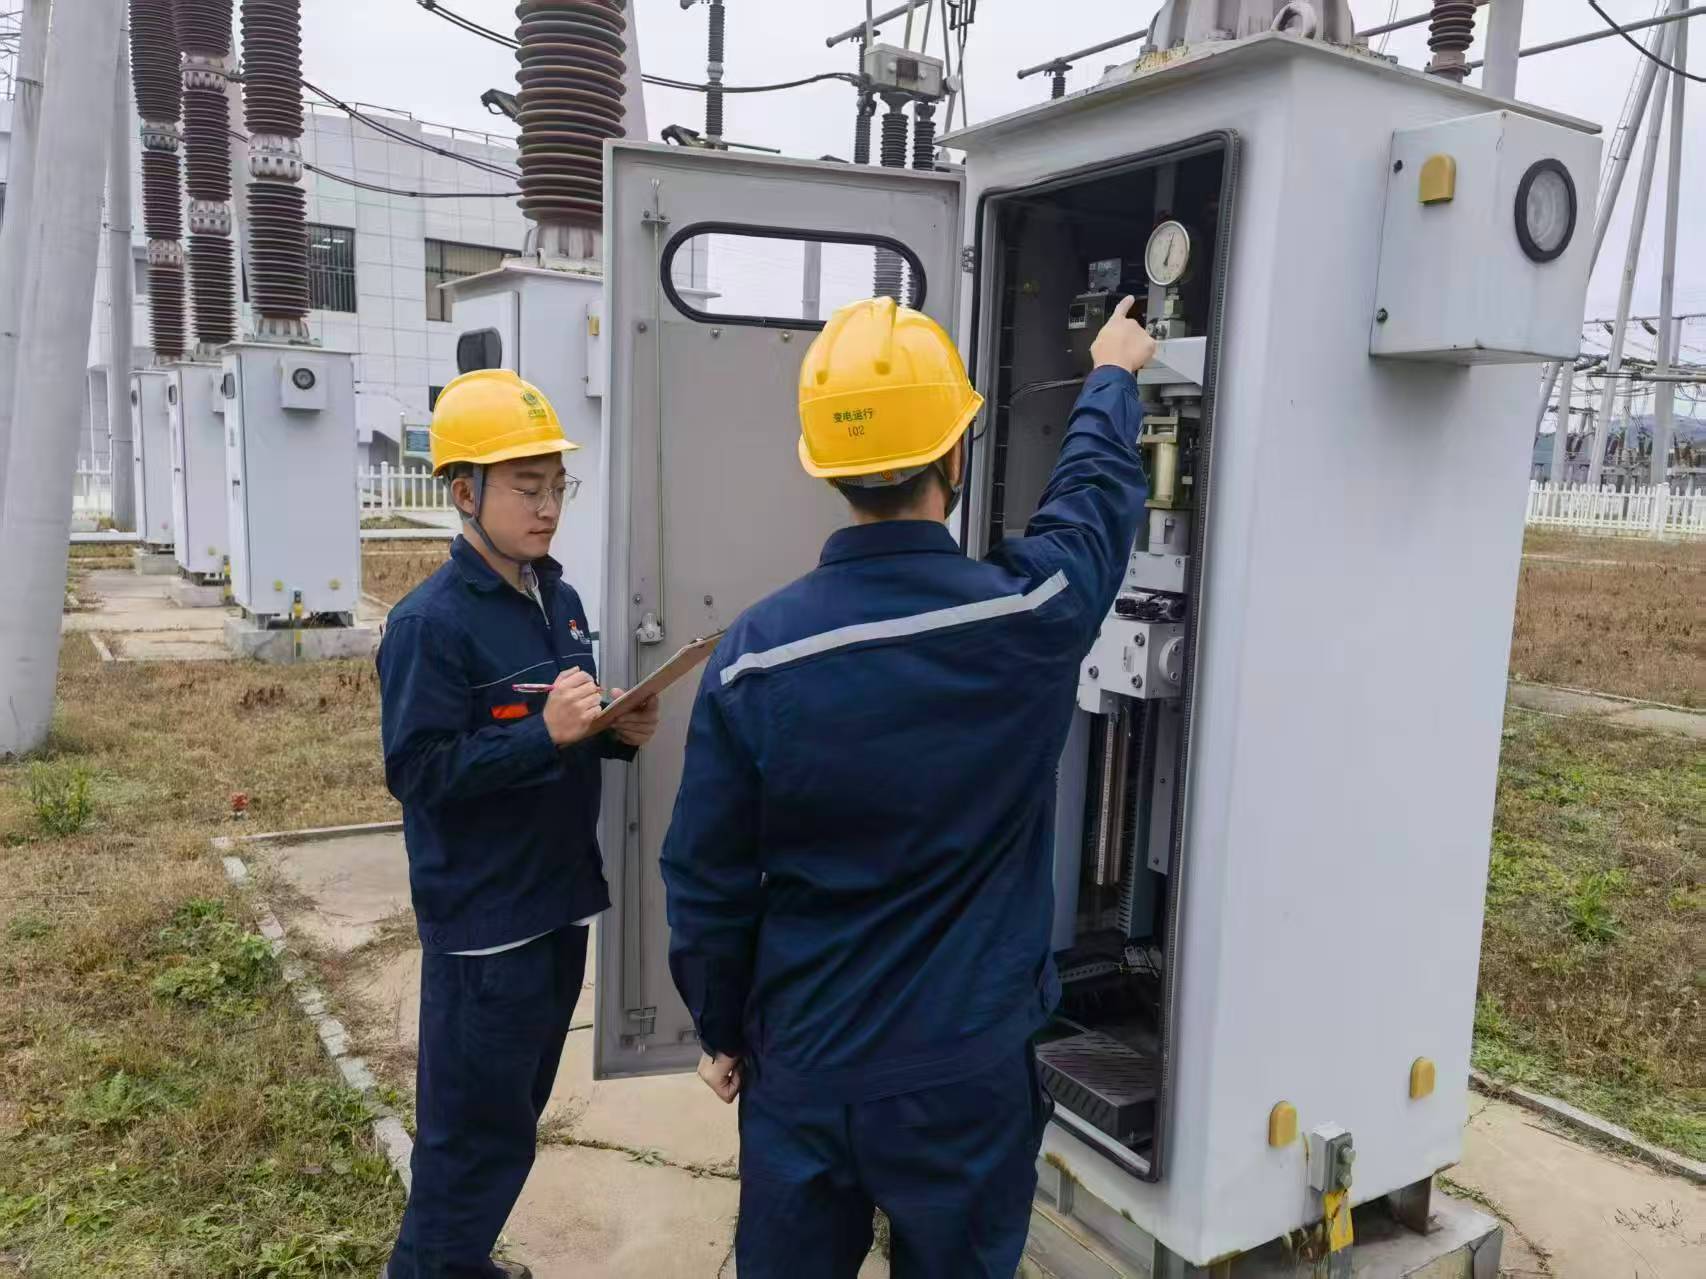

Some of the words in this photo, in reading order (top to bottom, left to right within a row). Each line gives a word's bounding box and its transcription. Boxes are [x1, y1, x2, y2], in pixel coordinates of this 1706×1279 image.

[833, 408, 873, 424] 变电运行
[847, 425, 865, 438] 102
